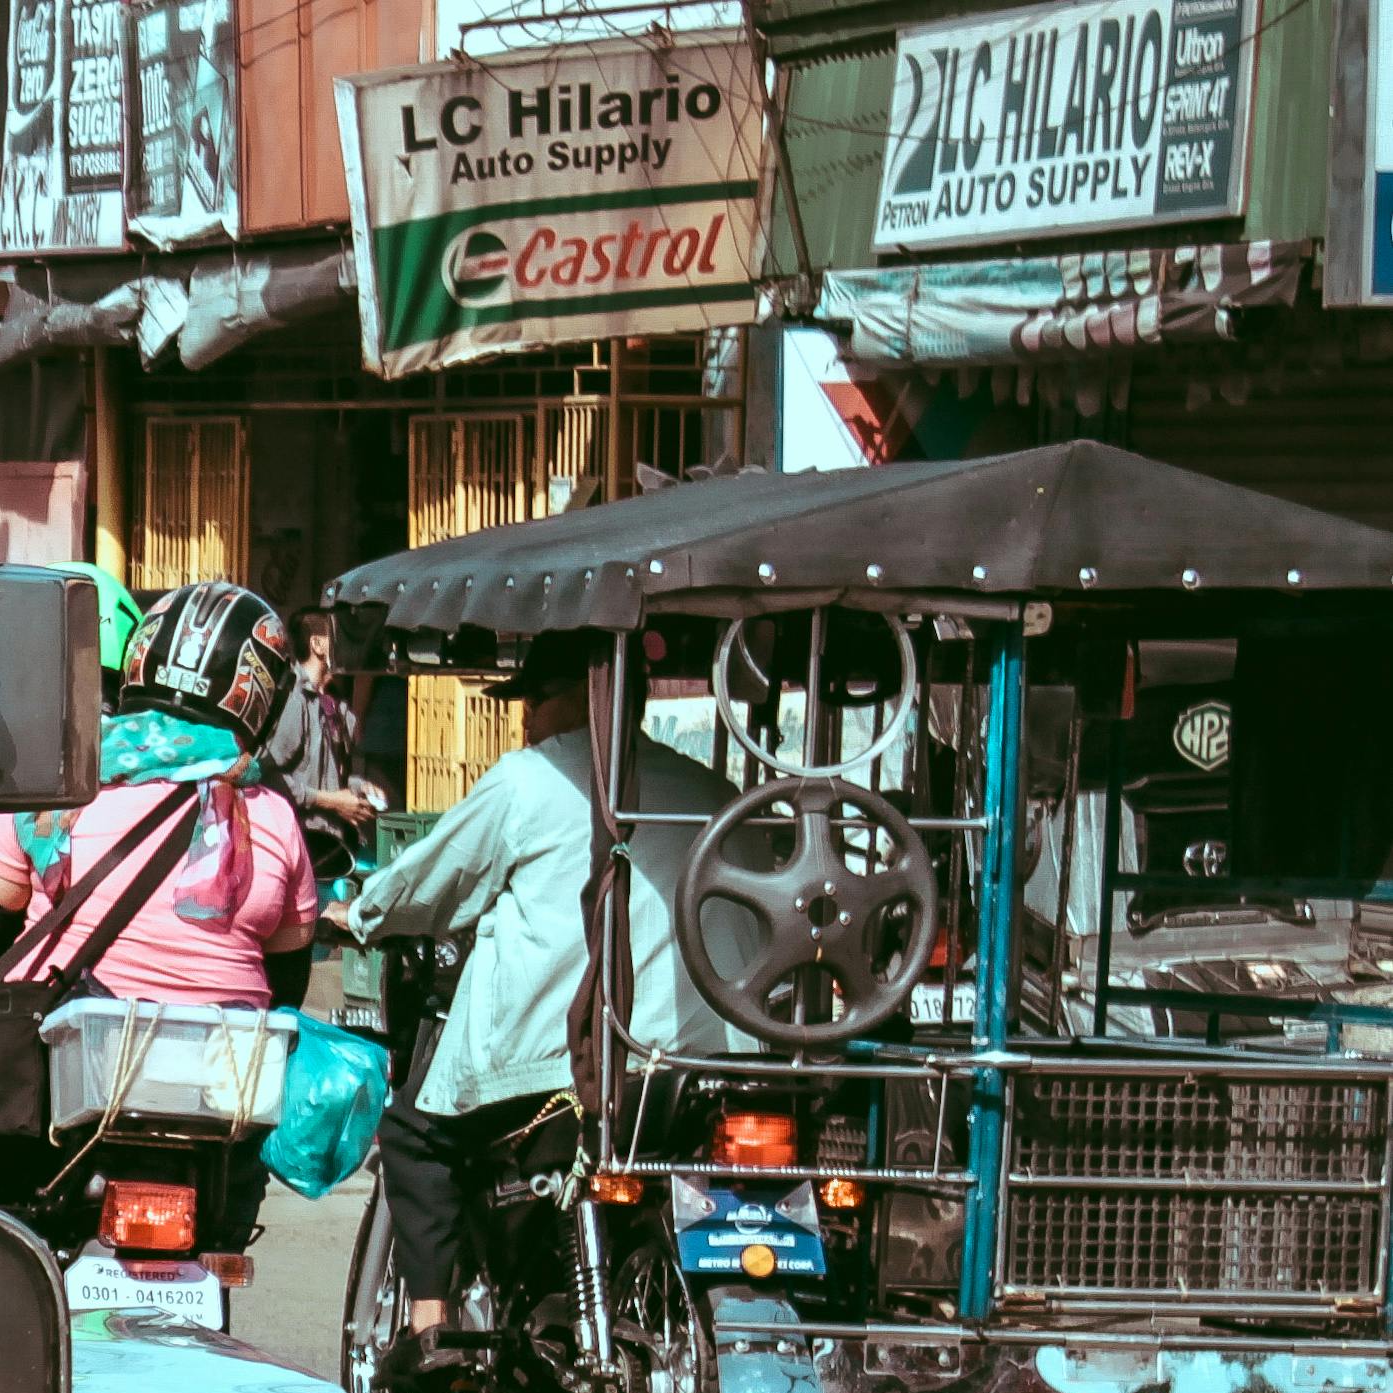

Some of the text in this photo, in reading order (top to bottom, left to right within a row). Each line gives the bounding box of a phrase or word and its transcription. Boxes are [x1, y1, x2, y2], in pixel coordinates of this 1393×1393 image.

[1176, 27, 1224, 67] Ultron
[69, 55, 122, 103] ZERO
[938, 8, 1165, 175] LC HILARIO
[1164, 81, 1211, 122] SPRINT
[69, 102, 122, 149] SUGAR
[401, 74, 721, 153] LC Hilario
[451, 135, 673, 185] Auto Supply
[1165, 139, 1214, 180] REV-X
[934, 154, 1153, 221] AUTO SUPPLY
[881, 198, 930, 232] PETRON
[513, 214, 726, 289] Castrol
[82, 1285, 119, 1302] 0301
[136, 1290, 204, 1305] 0416202
[105, 1268, 176, 1281] REGISTERED
